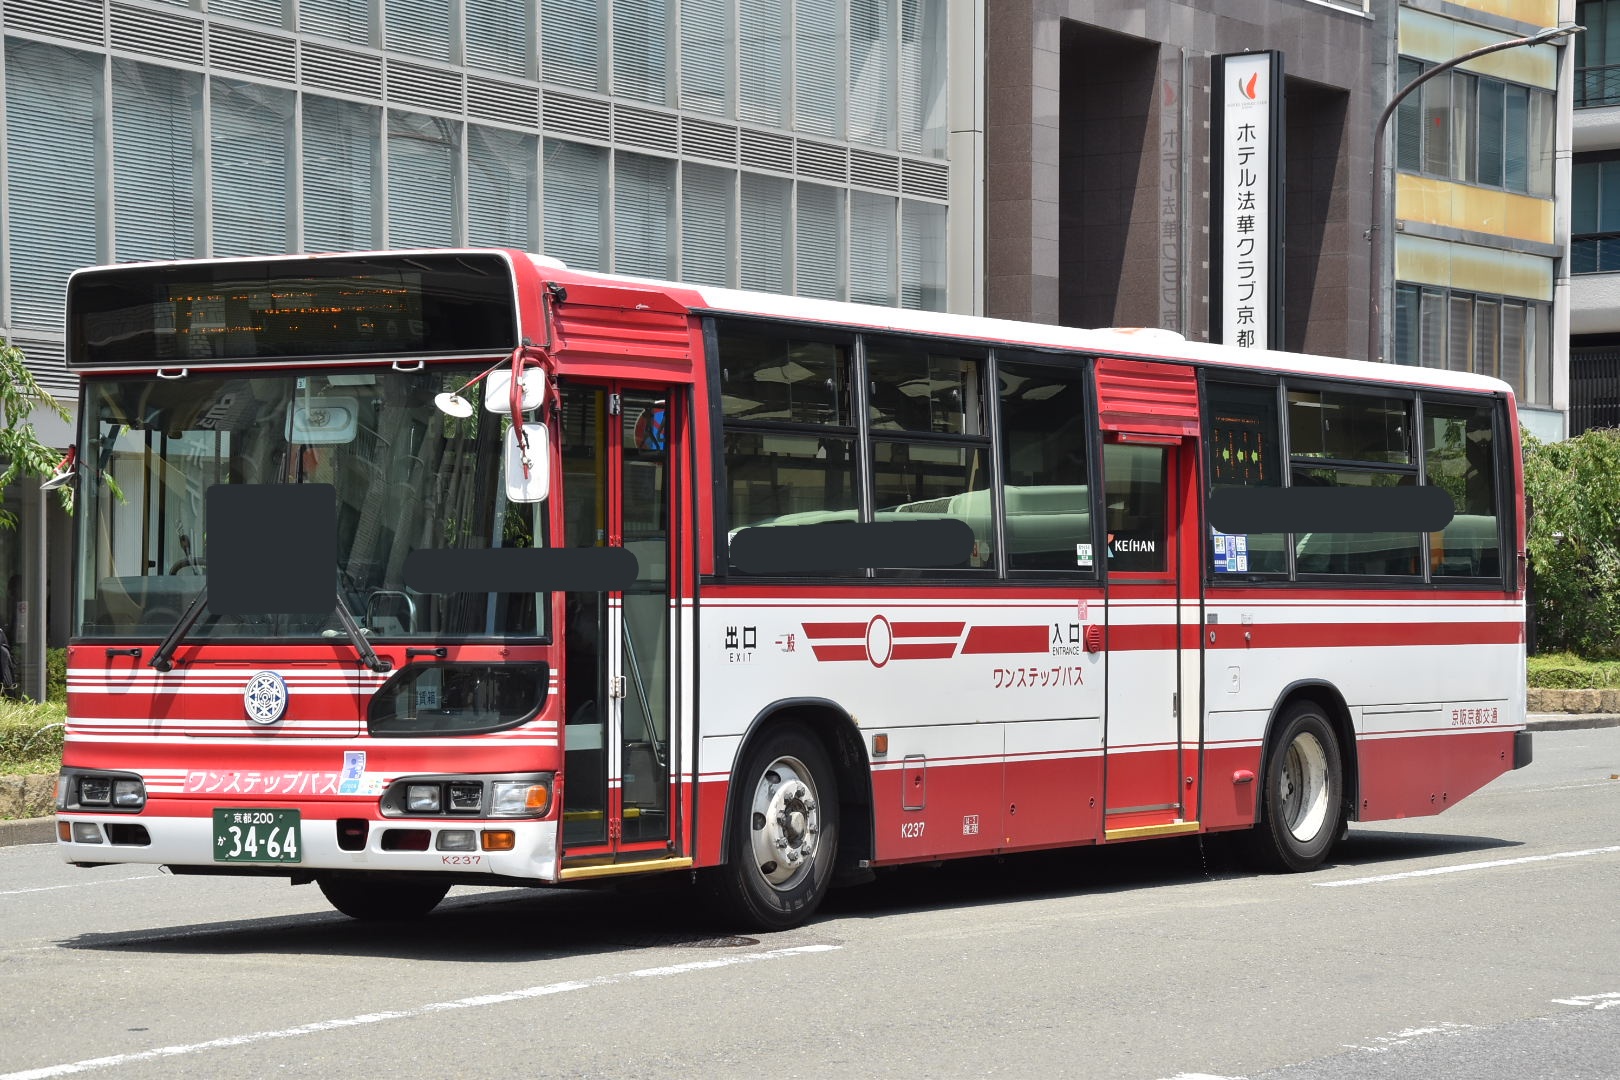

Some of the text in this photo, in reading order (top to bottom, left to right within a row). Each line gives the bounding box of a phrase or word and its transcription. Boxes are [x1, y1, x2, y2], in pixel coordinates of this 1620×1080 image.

[1236, 123, 1257, 348] ホテル法華クラブ京都
[1114, 538, 1155, 552] KEIHAN
[725, 625, 757, 650] 出口
[1052, 623, 1080, 644] 入口
[729, 652, 752, 663] EXIT
[1052, 646, 1080, 656] ENTRANCE
[993, 666, 1084, 689] ワンステップバス
[1451, 707, 1498, 726] 京阪京都交通
[188, 771, 338, 794] ワンステップバス
[901, 821, 926, 838] K237
[217, 825, 297, 858] か 34-64
[441, 855, 481, 865] K237
